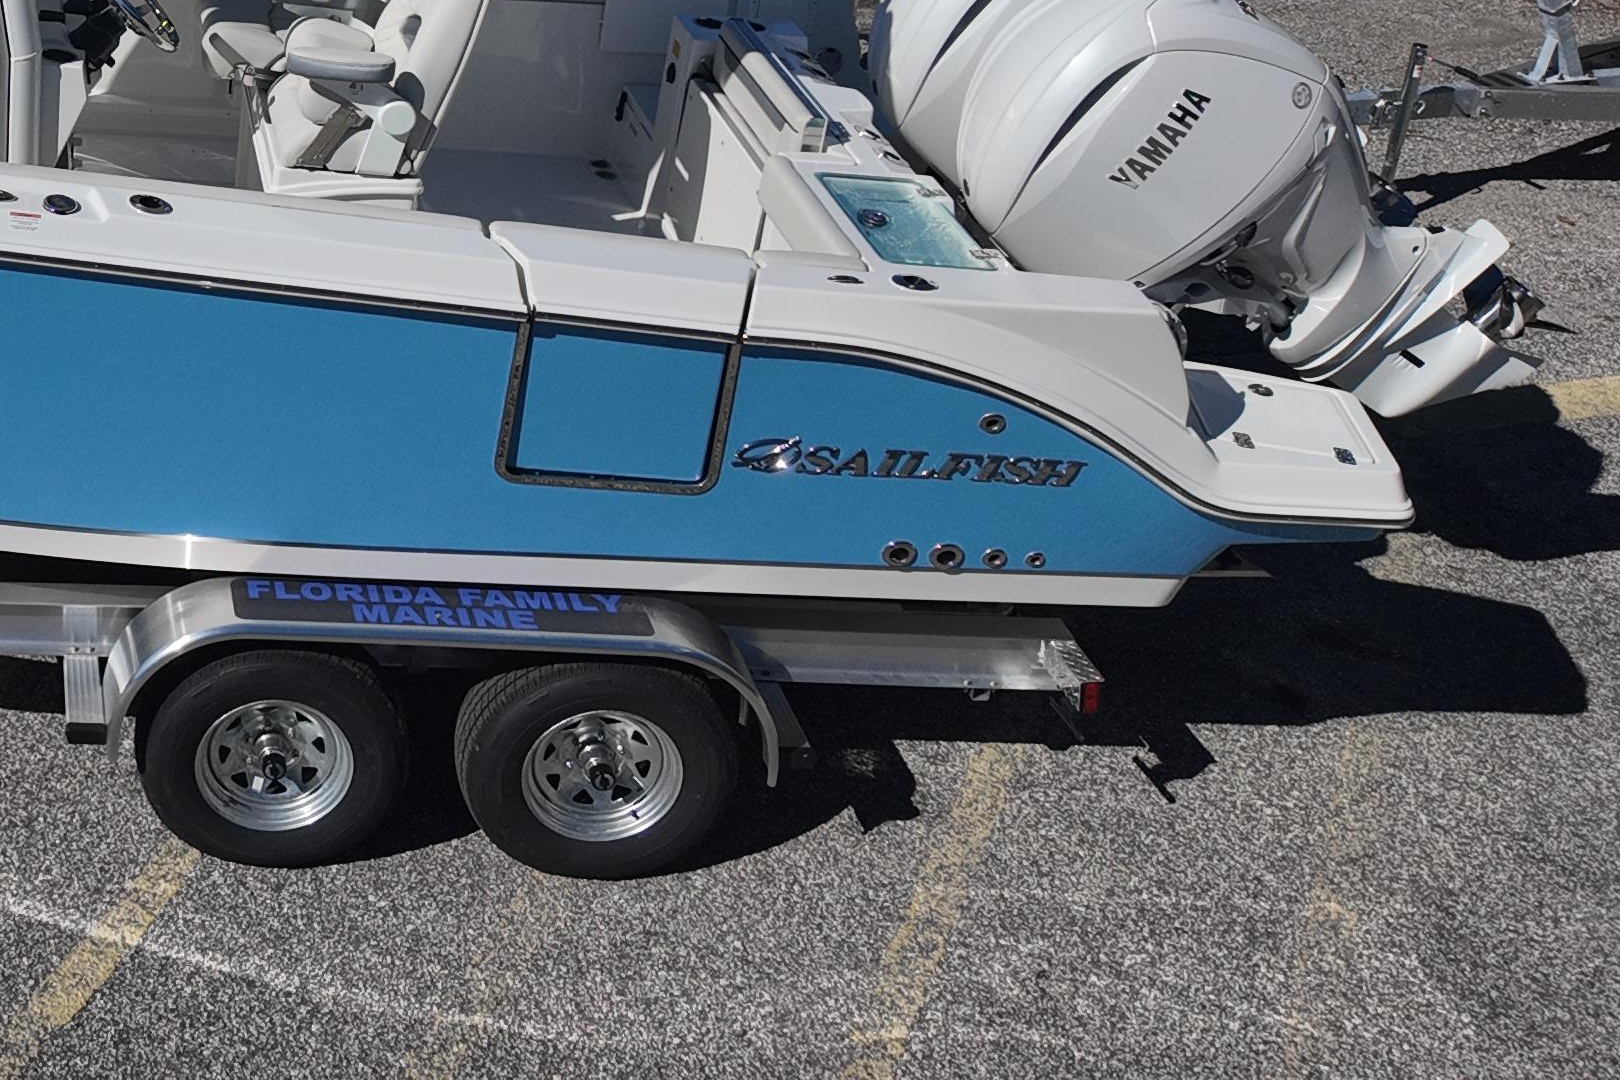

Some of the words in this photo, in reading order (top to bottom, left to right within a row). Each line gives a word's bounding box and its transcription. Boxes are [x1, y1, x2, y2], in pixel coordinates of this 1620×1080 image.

[1108, 88, 1212, 190] YAMAHA
[795, 445, 1089, 487] SAILFISH
[245, 579, 447, 606] FLORIDA
[456, 588, 623, 614] FAMILY
[349, 603, 540, 631] MARINE
